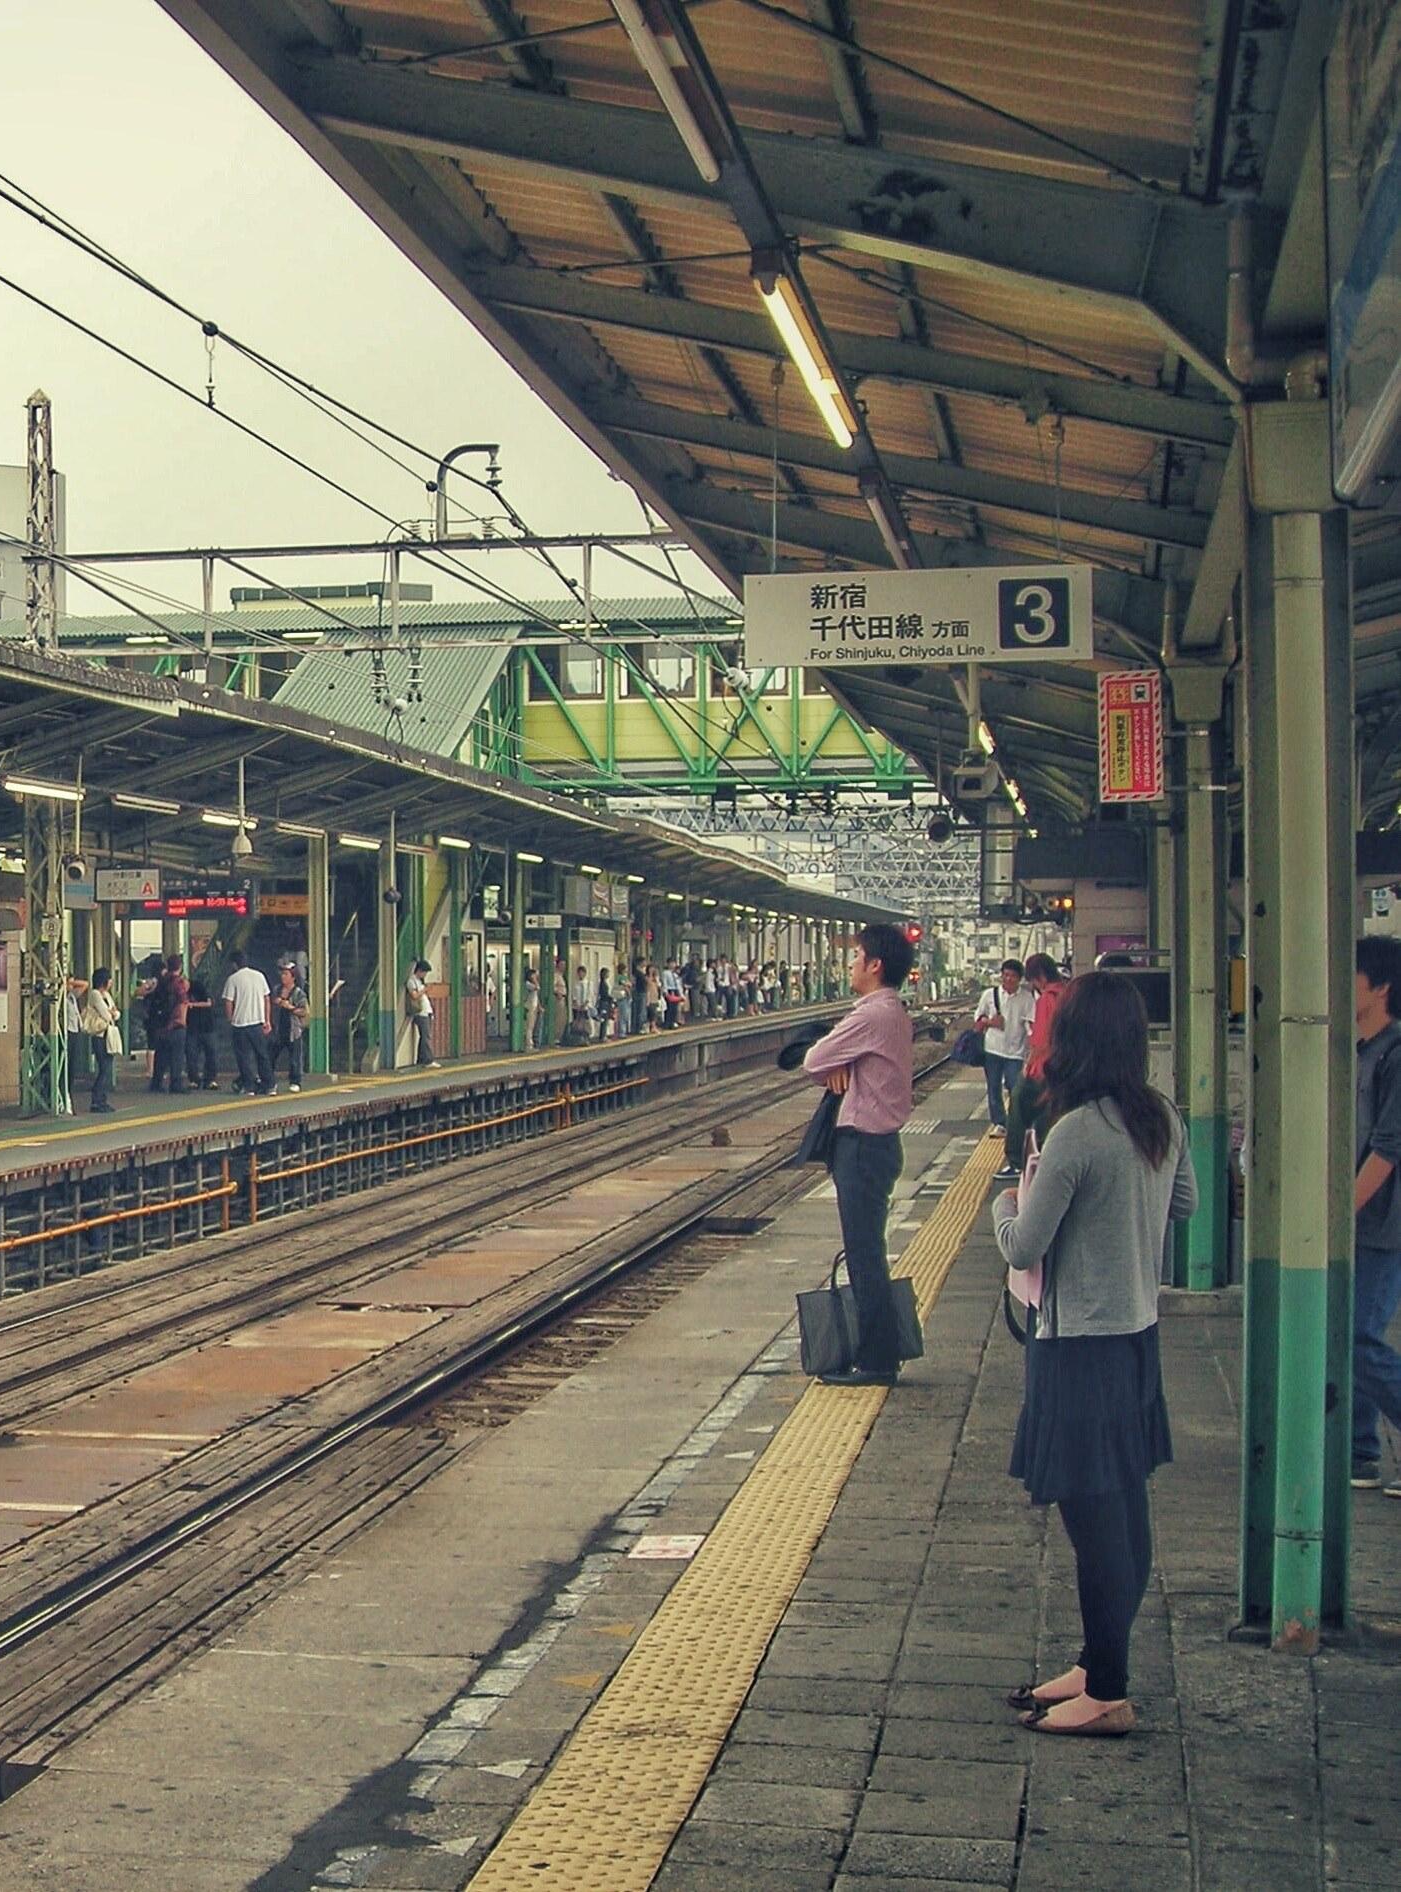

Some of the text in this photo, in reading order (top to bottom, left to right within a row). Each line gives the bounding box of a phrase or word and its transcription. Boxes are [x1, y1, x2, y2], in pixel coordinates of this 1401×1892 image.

[810, 583, 867, 610] 新宿
[1014, 585, 1056, 644] 3
[809, 613, 970, 642] 千代田線 方面
[810, 644, 985, 661] For Shinjuku, Chiyoda Line
[142, 881, 153, 895] A
[243, 879, 251, 889] 2
